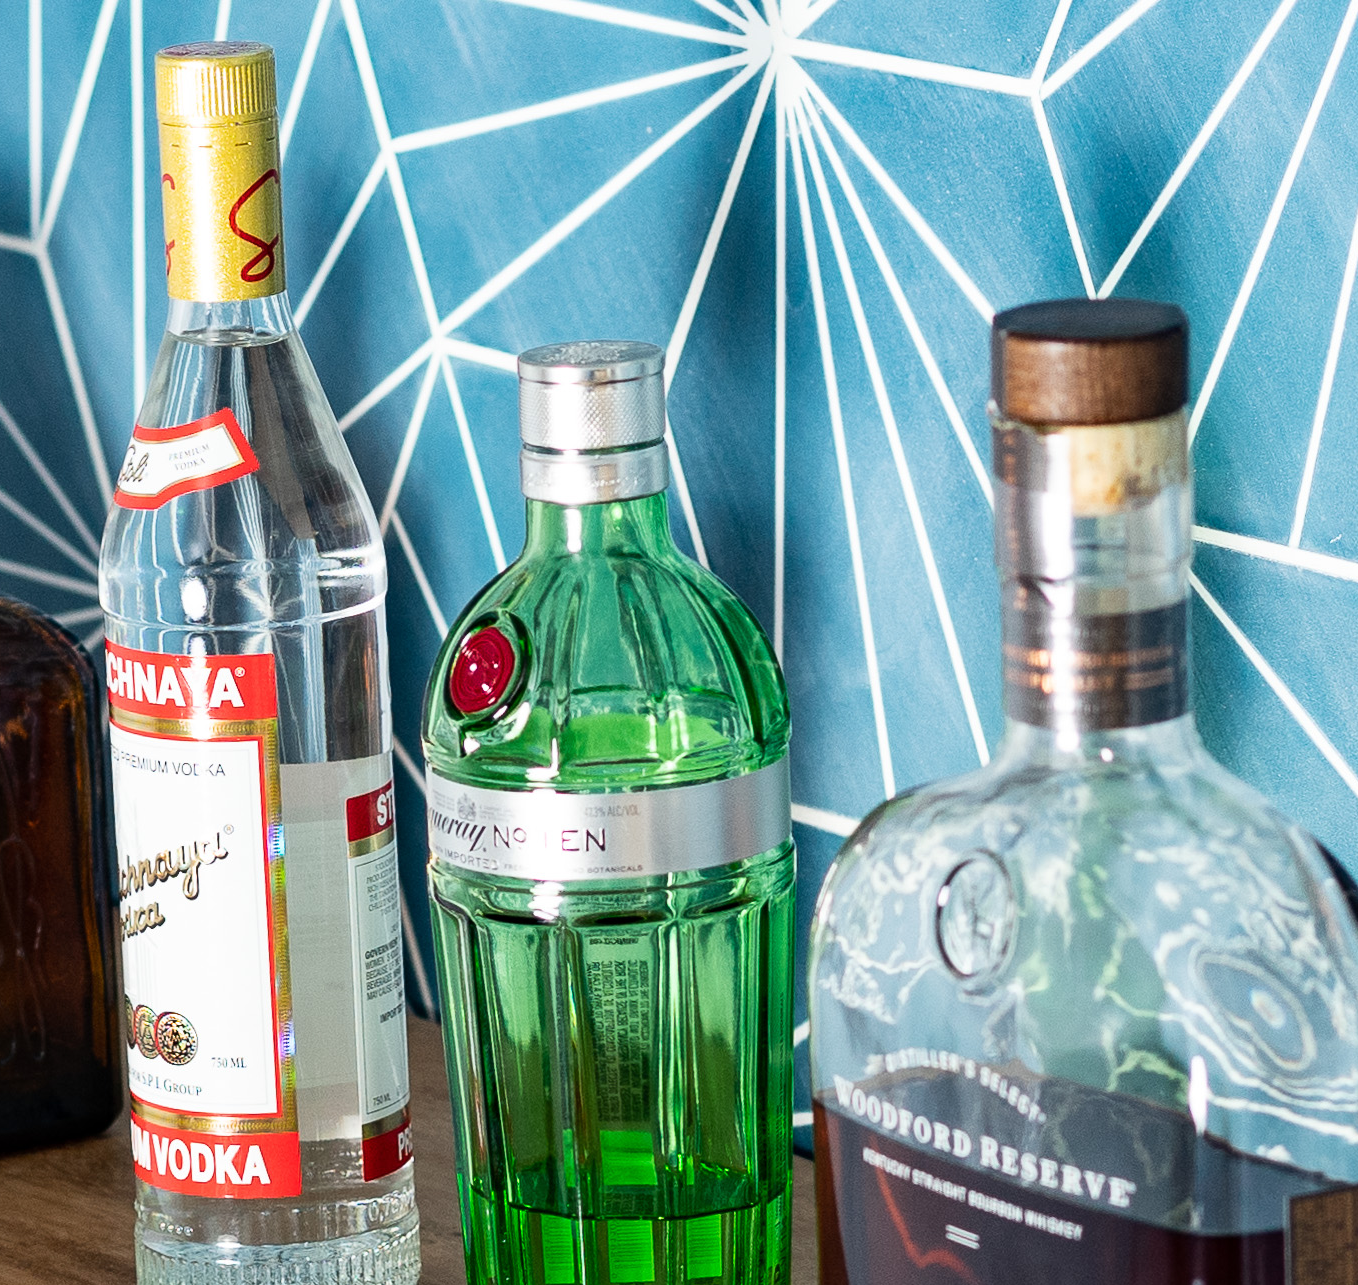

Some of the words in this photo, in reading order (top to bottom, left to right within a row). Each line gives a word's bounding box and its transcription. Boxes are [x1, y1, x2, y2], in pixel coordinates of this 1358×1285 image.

[168, 443, 210, 461] PREMIUM
[174, 457, 206, 471] VODKA
[105, 648, 245, 708] CHNAYA
[444, 849, 499, 871] IMPORTED
[212, 1057, 228, 1069] 750
[230, 1057, 248, 1069] ML
[163, 1079, 203, 1097] GROUP
[834, 1074, 973, 1159] WOODFORD
[980, 1135, 1131, 1209] RESERVE
[152, 1133, 271, 1184] VODKA
